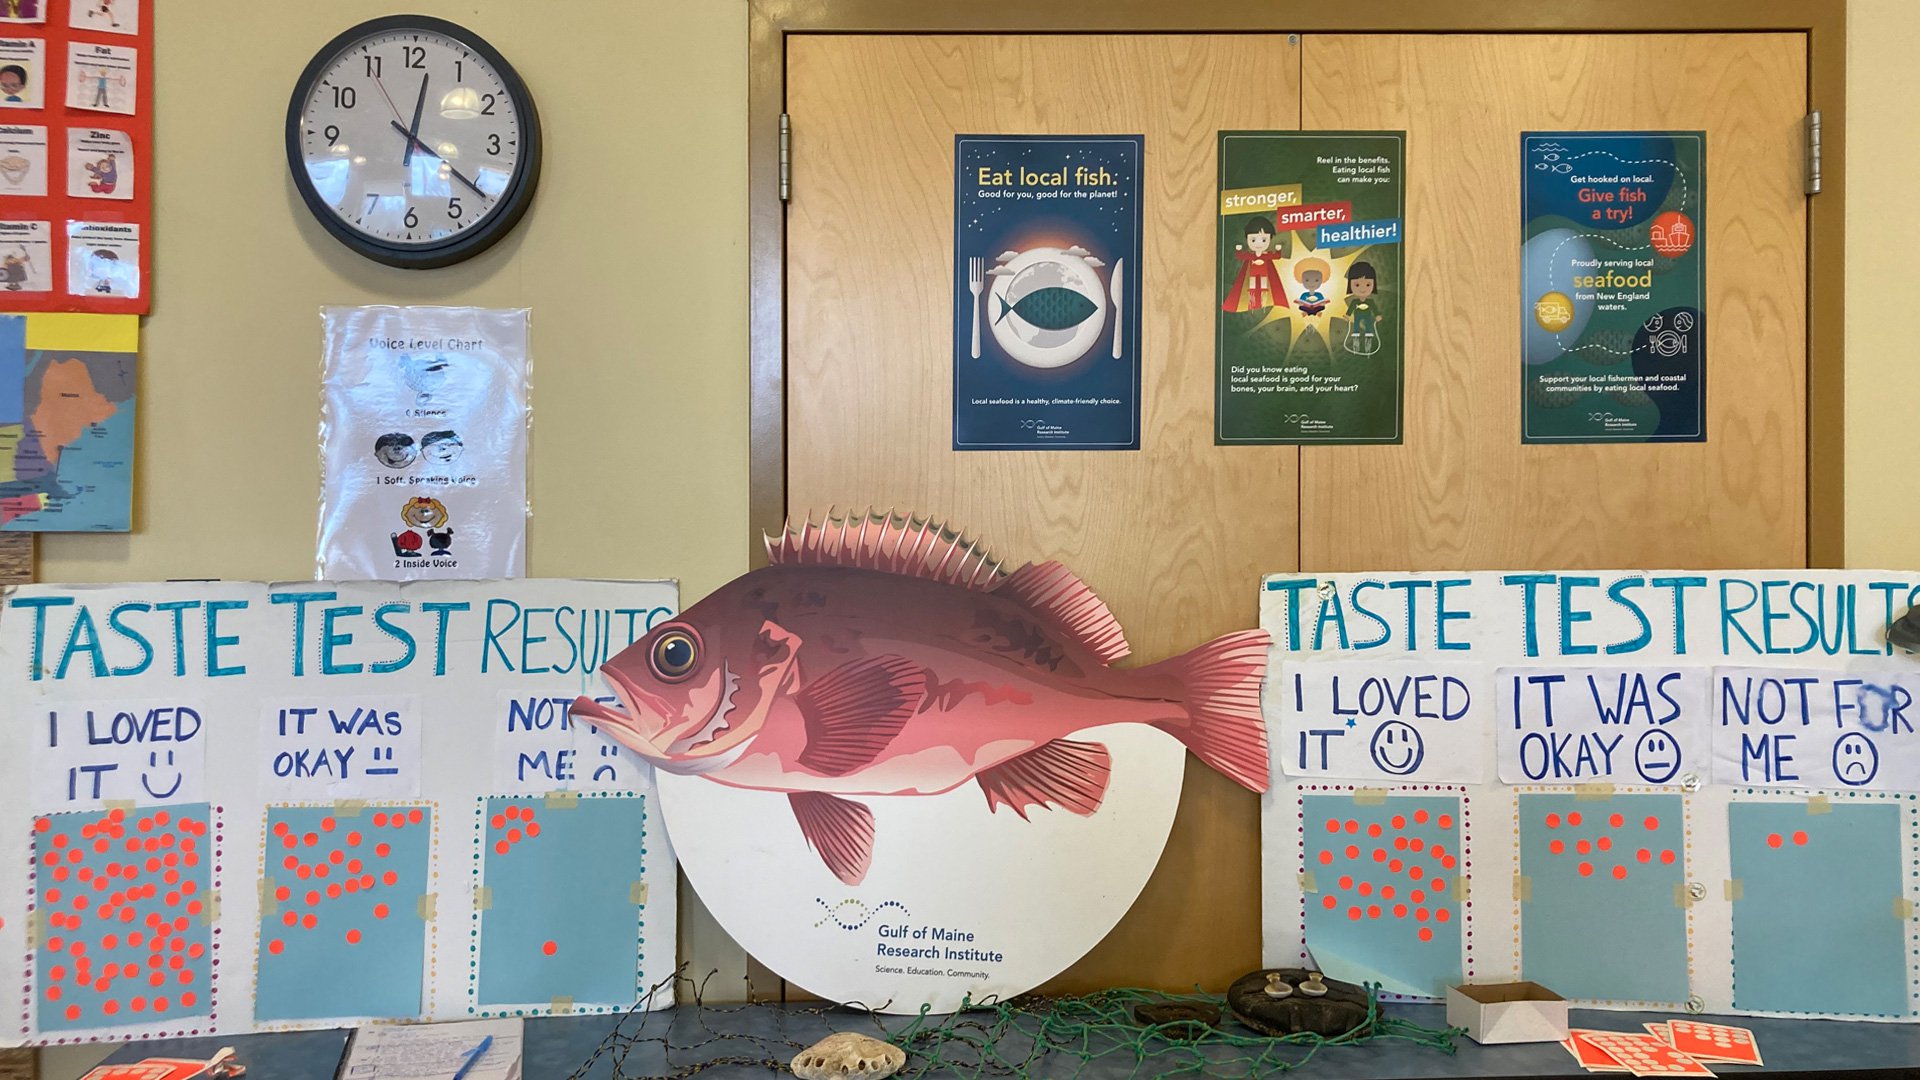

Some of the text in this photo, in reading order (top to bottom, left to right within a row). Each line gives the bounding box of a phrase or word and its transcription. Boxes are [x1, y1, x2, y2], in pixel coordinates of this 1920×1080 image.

[364, 56, 381, 78] 11
[403, 46, 426, 69] 12
[455, 61, 462, 82] 1
[332, 86, 356, 109] 10
[481, 94, 495, 115] 2
[90, 131, 110, 139] Zinc
[324, 125, 339, 147] 9
[486, 134, 500, 156] 3
[978, 167, 1118, 186] Eat local fish.
[1333, 166, 1390, 175] Eating local fish
[1633, 175, 1654, 183] local.
[366, 194, 379, 215] 7
[978, 190, 1118, 200] Good for you, good for the planet!
[1225, 191, 1297, 208] stronger,
[1578, 187, 1647, 202] Give fish
[404, 207, 418, 229] 6
[447, 198, 462, 219] 5
[1281, 207, 1346, 224] smarter,
[1592, 206, 1633, 223] a try!
[1321, 223, 1397, 243] healthier!
[1571, 259, 1654, 268] Proudly serving local
[1573, 270, 1652, 288] seafood
[1617, 292, 1650, 301] England
[410, 338, 443, 349] Level
[447, 338, 485, 350] Chart
[1284, 366, 1308, 375] eating
[1290, 376, 1310, 384] good
[1324, 376, 1341, 384] your
[1539, 376, 1569, 384] Support
[1661, 374, 1686, 382] coastal
[1231, 385, 1256, 393] bones,
[1258, 386, 1275, 394] your
[1276, 385, 1298, 393] brain,
[1593, 385, 1603, 393] by
[1605, 384, 1627, 393] eating
[395, 559, 457, 568] 2 Inside Voice
[1264, 578, 1472, 651] TASTE
[1501, 574, 1707, 656] TEST
[9, 596, 250, 681] TASTE
[269, 591, 470, 676] TEST
[1295, 673, 1471, 720] I LOVED
[1514, 672, 1681, 729] IT WAS
[1722, 677, 1914, 734] NOT FOR
[279, 707, 402, 736] IT WAS
[508, 698, 575, 732] NOT
[50, 707, 201, 747] I LOVED
[1298, 729, 1345, 770] IT
[1519, 731, 1624, 780] OKAY
[1742, 733, 1799, 782] ME
[274, 747, 354, 779] OKAY
[518, 750, 576, 781] ME
[68, 763, 119, 800] IT
[878, 925, 974, 942] Gulf of Maine
[877, 944, 1003, 962] Research Institute
[876, 965, 990, 980] Science. Education. Community.
